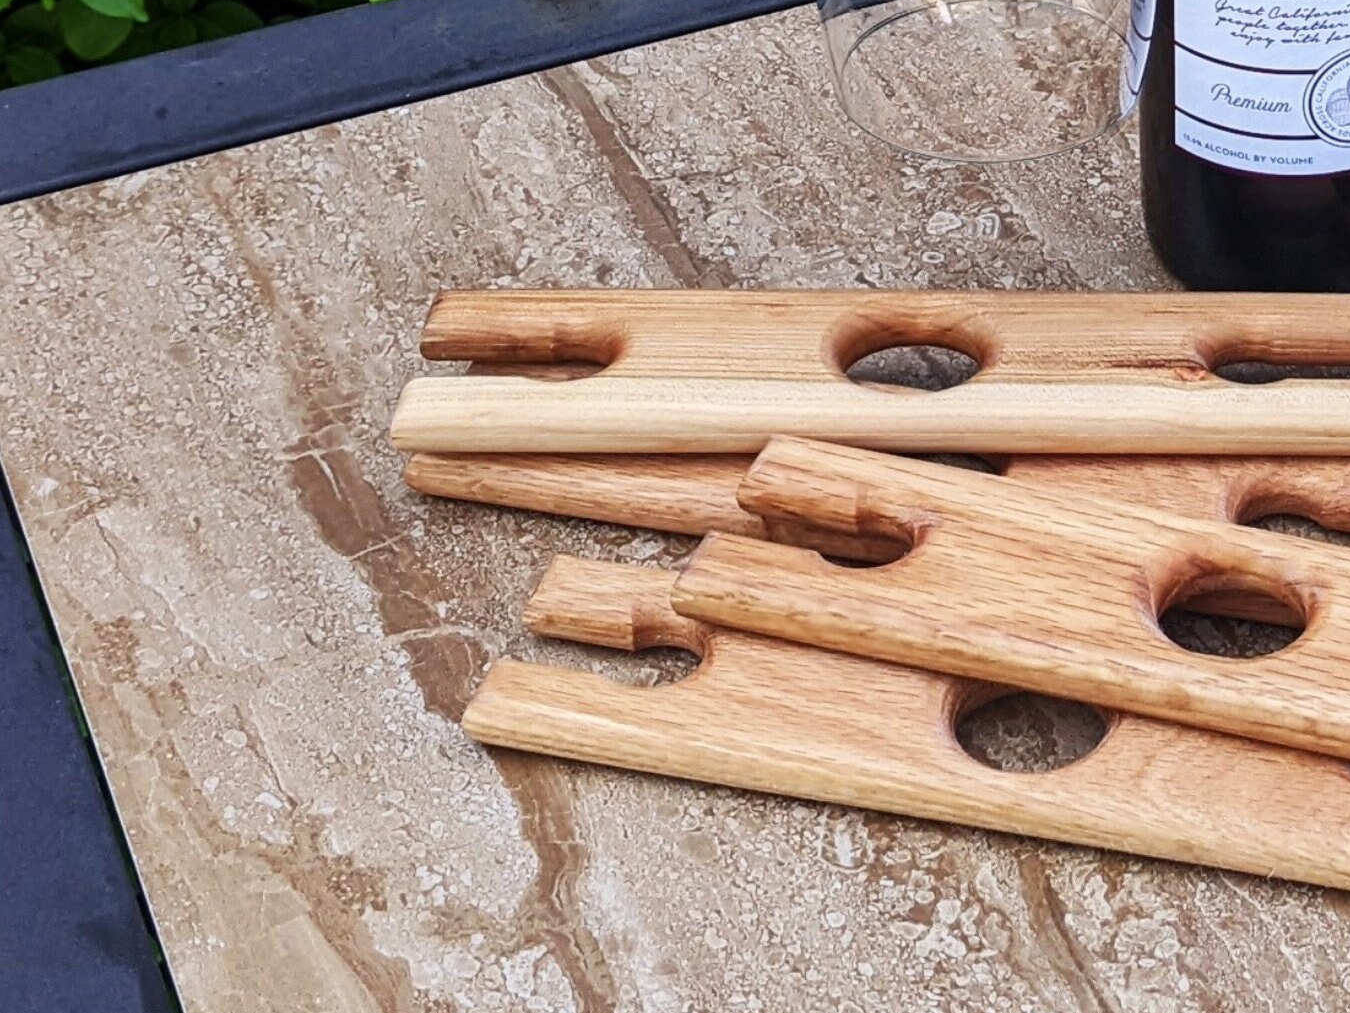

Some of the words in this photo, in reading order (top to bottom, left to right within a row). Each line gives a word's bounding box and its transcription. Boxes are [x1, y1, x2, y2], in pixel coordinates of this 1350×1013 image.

[1210, 82, 1292, 114] Premium
[1204, 142, 1251, 161] ALCOHOL
[1253, 154, 1267, 163] BY
[1269, 157, 1314, 165] VOLUME
